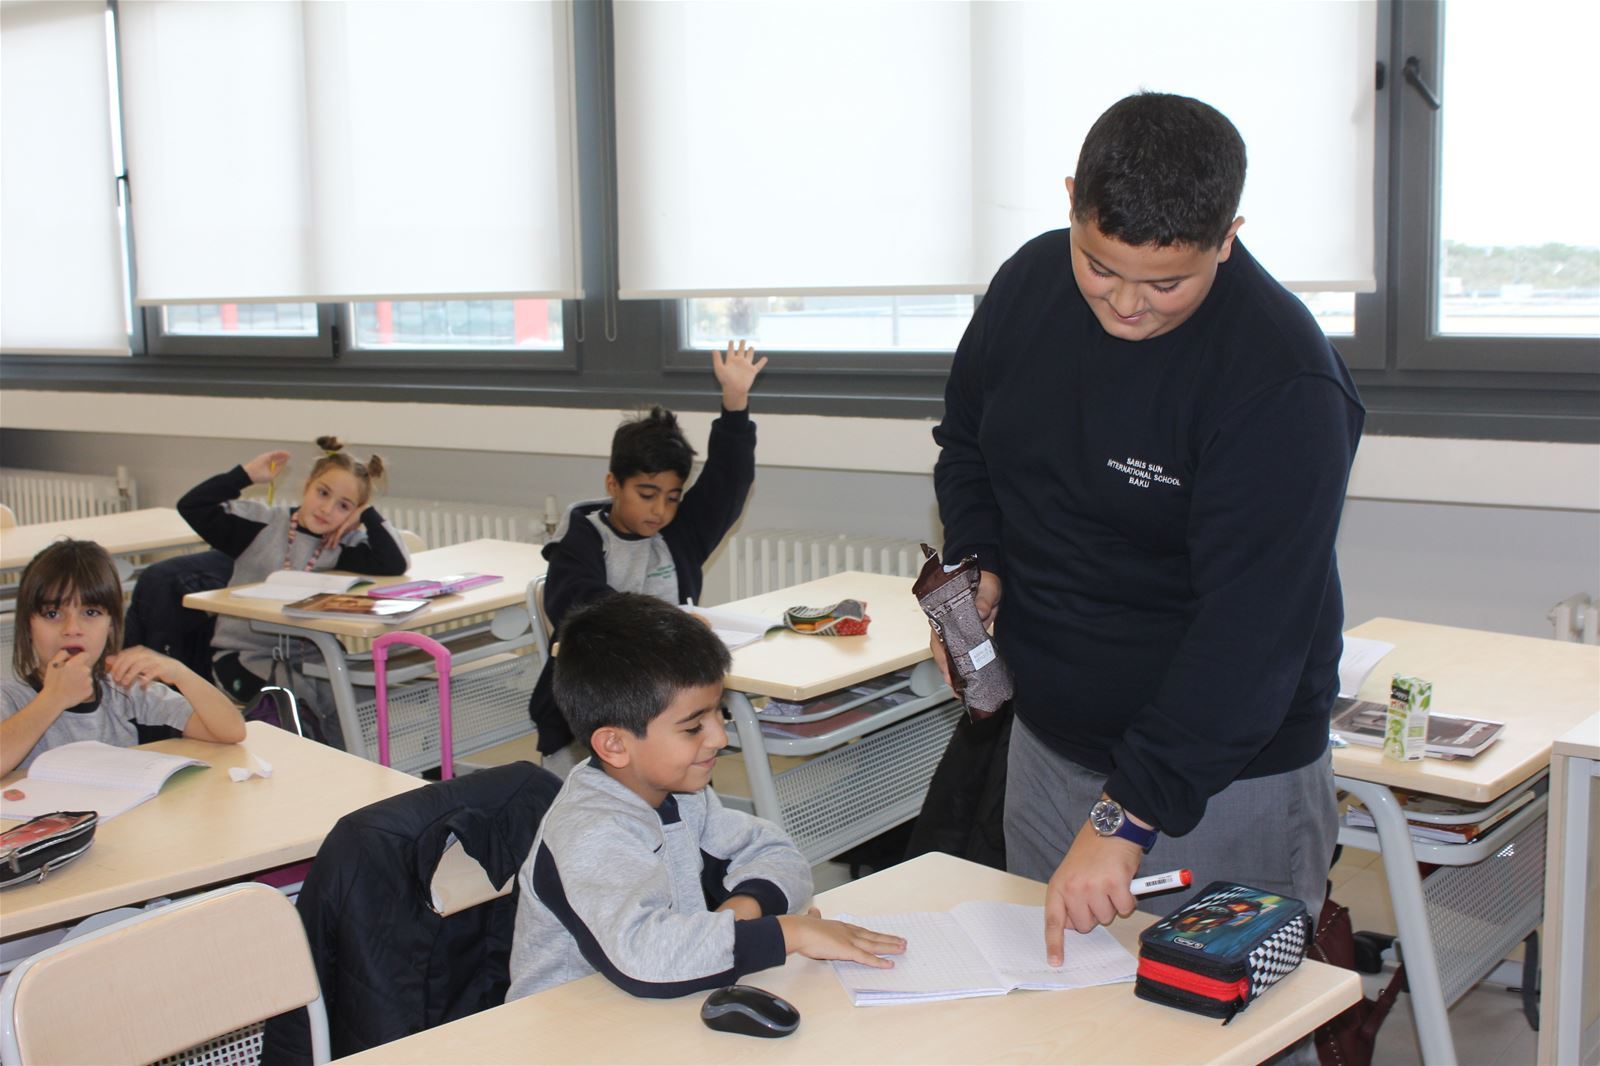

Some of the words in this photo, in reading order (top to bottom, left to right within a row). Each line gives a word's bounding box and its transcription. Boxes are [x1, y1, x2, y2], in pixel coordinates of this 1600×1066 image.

[1106, 458, 1152, 480] INTERNATIONAL
[1153, 474, 1181, 486] SCHOOL
[1126, 457, 1147, 469] SABIS
[1147, 464, 1163, 474] SUN
[1128, 476, 1150, 488] BAKU
